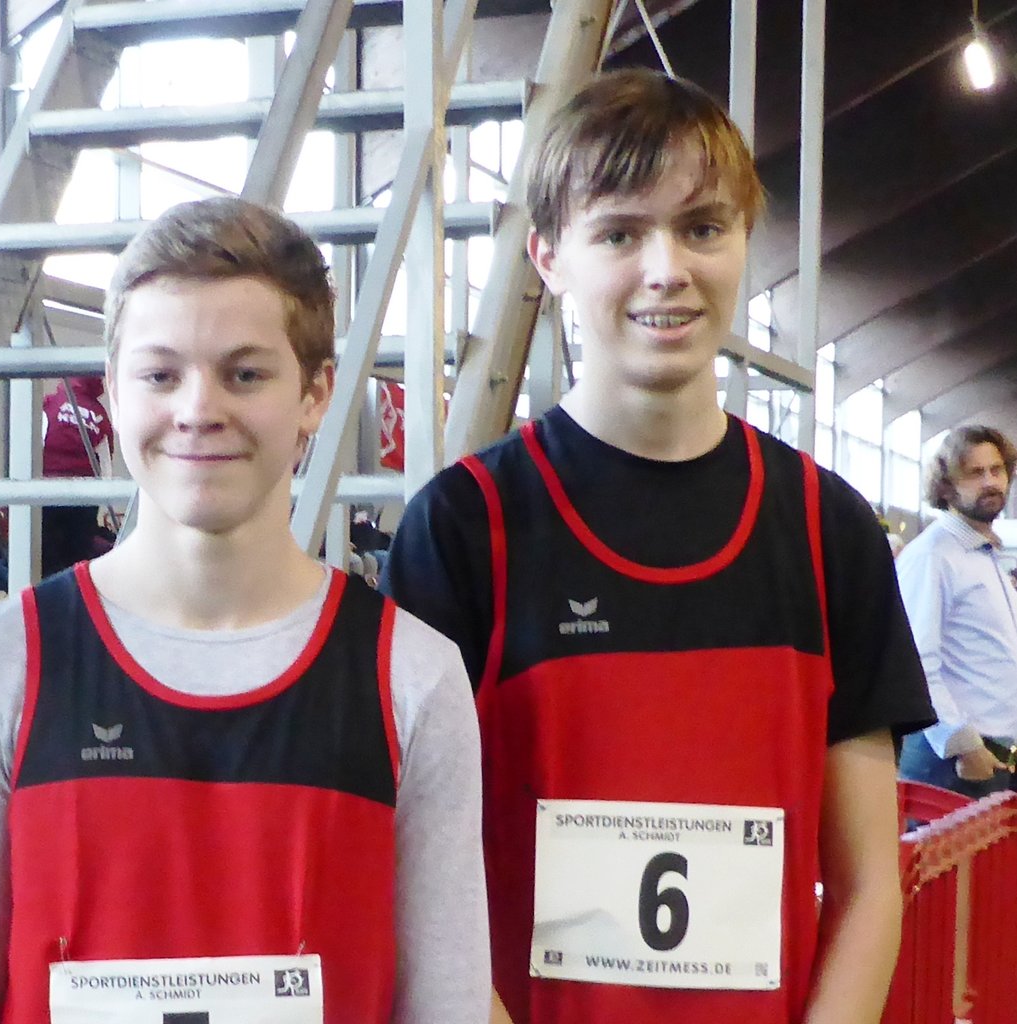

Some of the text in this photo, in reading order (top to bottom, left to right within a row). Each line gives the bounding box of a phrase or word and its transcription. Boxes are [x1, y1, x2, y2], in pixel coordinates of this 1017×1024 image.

[559, 619, 609, 635] erima
[81, 744, 133, 760] erima
[555, 814, 732, 832] SPORTDIENSTLEISTUNGEN
[632, 832, 681, 842] SCHMIDT
[638, 851, 690, 952] 6
[585, 955, 732, 975] WWW.ZEITMESS.DE
[70, 972, 261, 989] SPORTDIENSTLEISTUNGEN
[150, 989, 202, 1000] SCHMIDT
